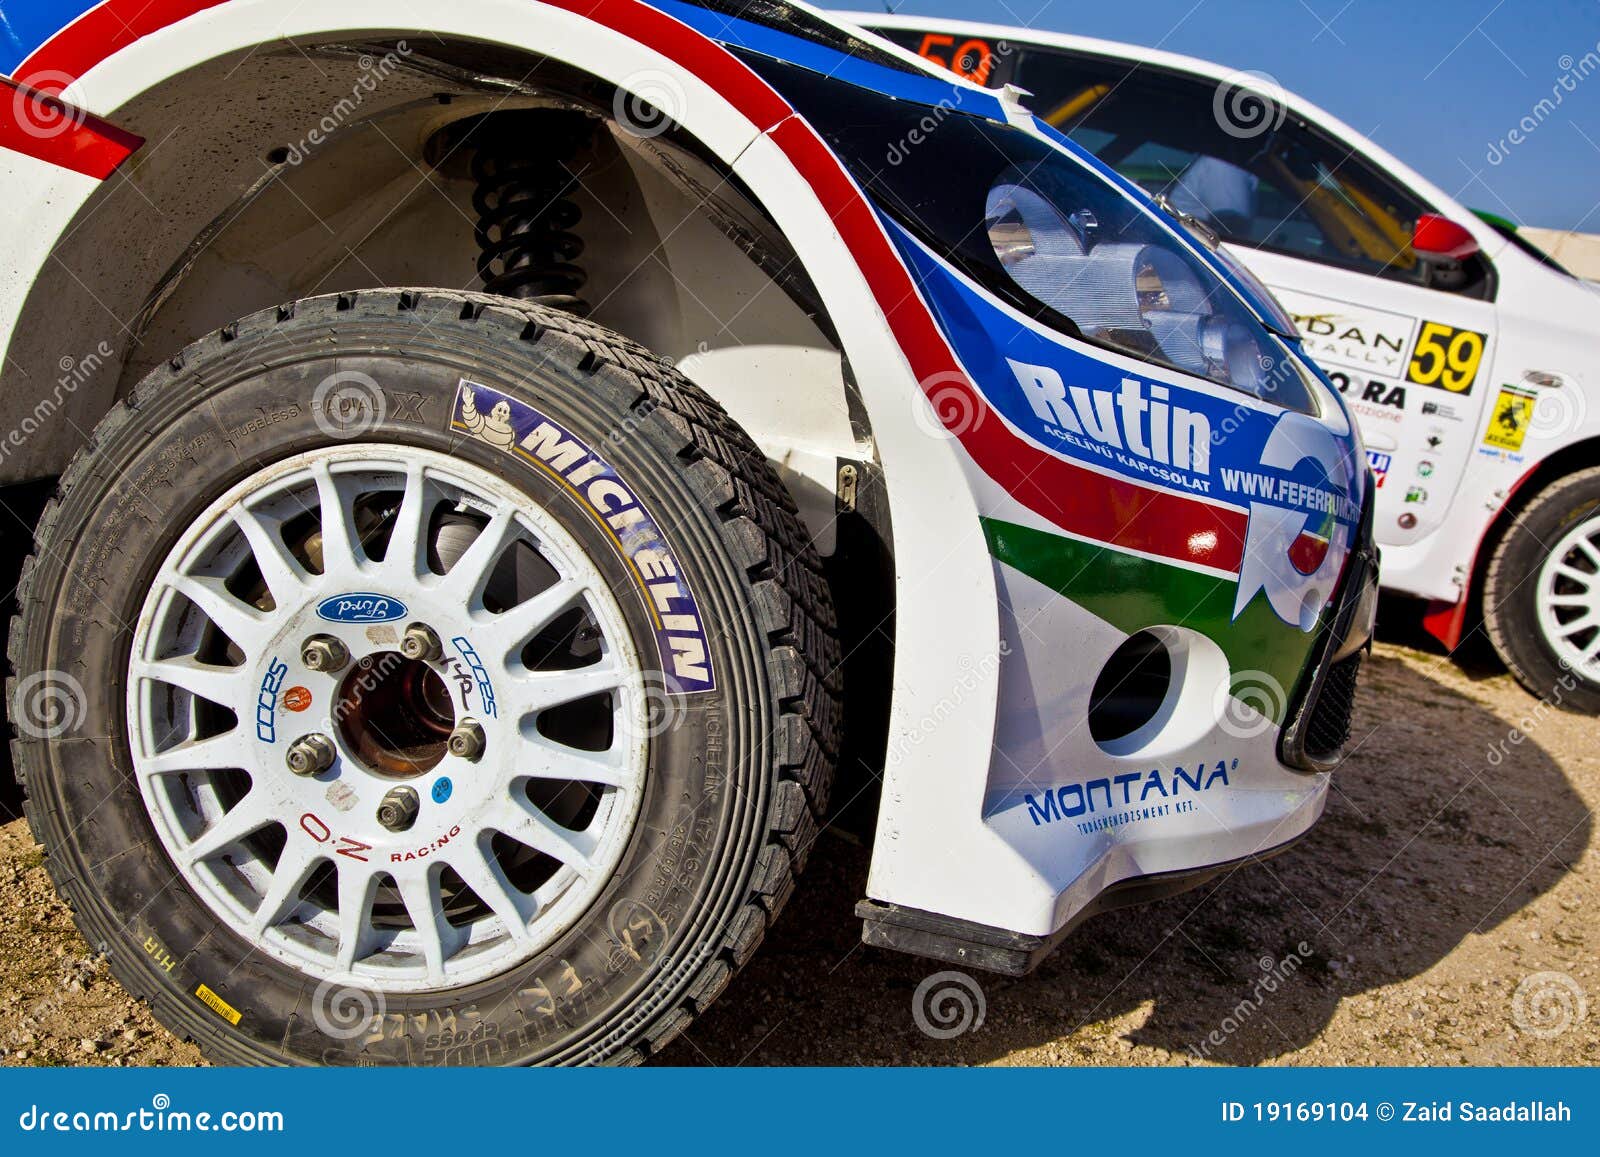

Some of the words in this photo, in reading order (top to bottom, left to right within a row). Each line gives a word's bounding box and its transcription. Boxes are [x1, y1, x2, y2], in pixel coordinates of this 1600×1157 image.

[1294, 315, 1403, 353] DAN
[1407, 321, 1484, 393] 59
[230, 407, 299, 440] TUBELESS
[1005, 357, 1210, 476] Rutin
[1117, 454, 1211, 493] KAPCSOLAT
[336, 599, 390, 619] Ford
[703, 695, 724, 802] MICHELIN
[143, 935, 176, 973] H1R
[425, 1021, 499, 1050] CROSS
